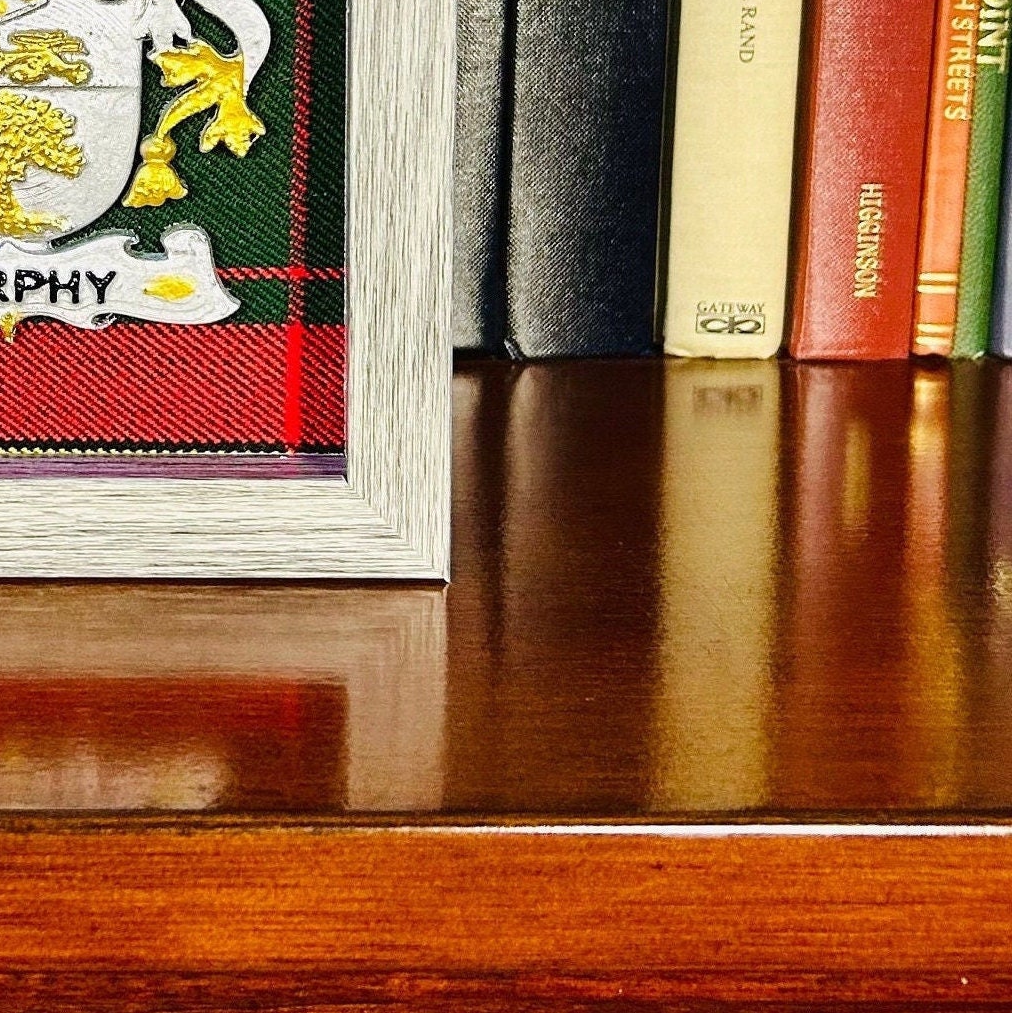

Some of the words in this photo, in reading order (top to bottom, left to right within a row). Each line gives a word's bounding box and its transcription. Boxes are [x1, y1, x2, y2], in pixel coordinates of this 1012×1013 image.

[739, 6, 758, 64] RAND
[944, 15, 975, 122] STREETS
[853, 182, 885, 299] HIGGINSON
